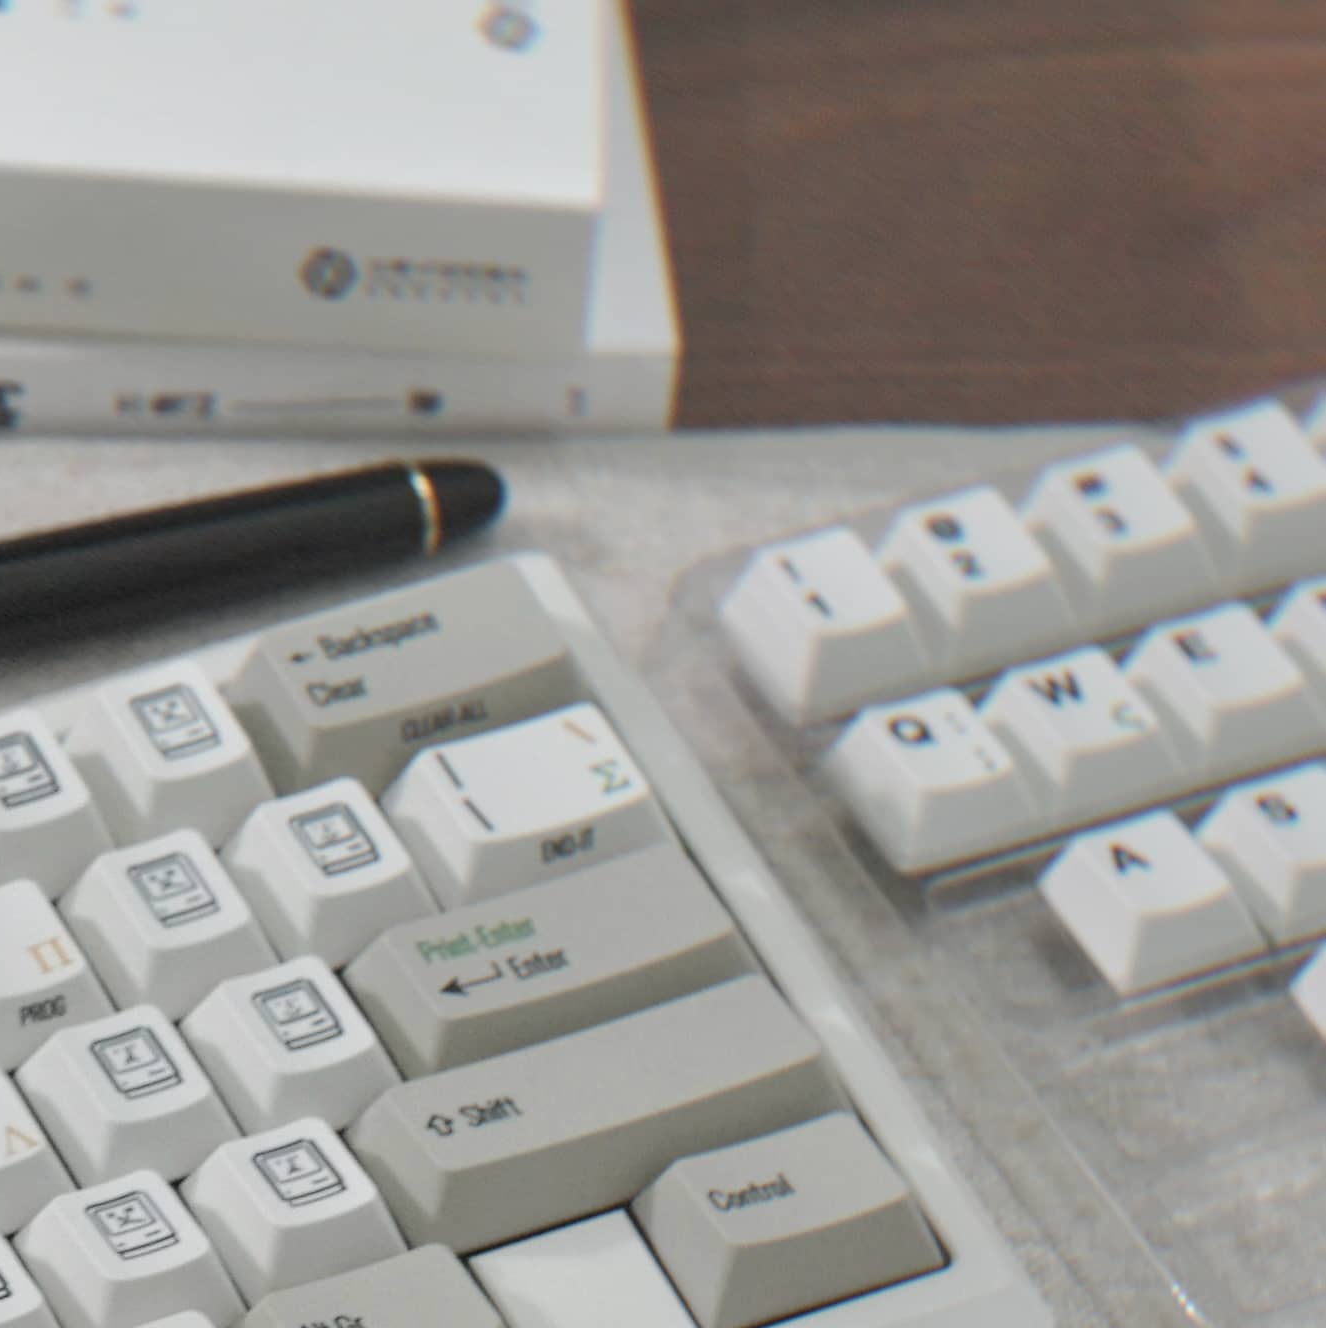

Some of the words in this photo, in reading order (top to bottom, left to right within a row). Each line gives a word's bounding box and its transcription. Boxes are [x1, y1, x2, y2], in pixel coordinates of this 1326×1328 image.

[317, 609, 441, 662] Backspace
[1029, 670, 1084, 706] W
[1109, 842, 1151, 873] A
[475, 917, 535, 948] Enter
[506, 949, 569, 980] Enter
[458, 1094, 523, 1131] Shift
[706, 1173, 797, 1213] Control
